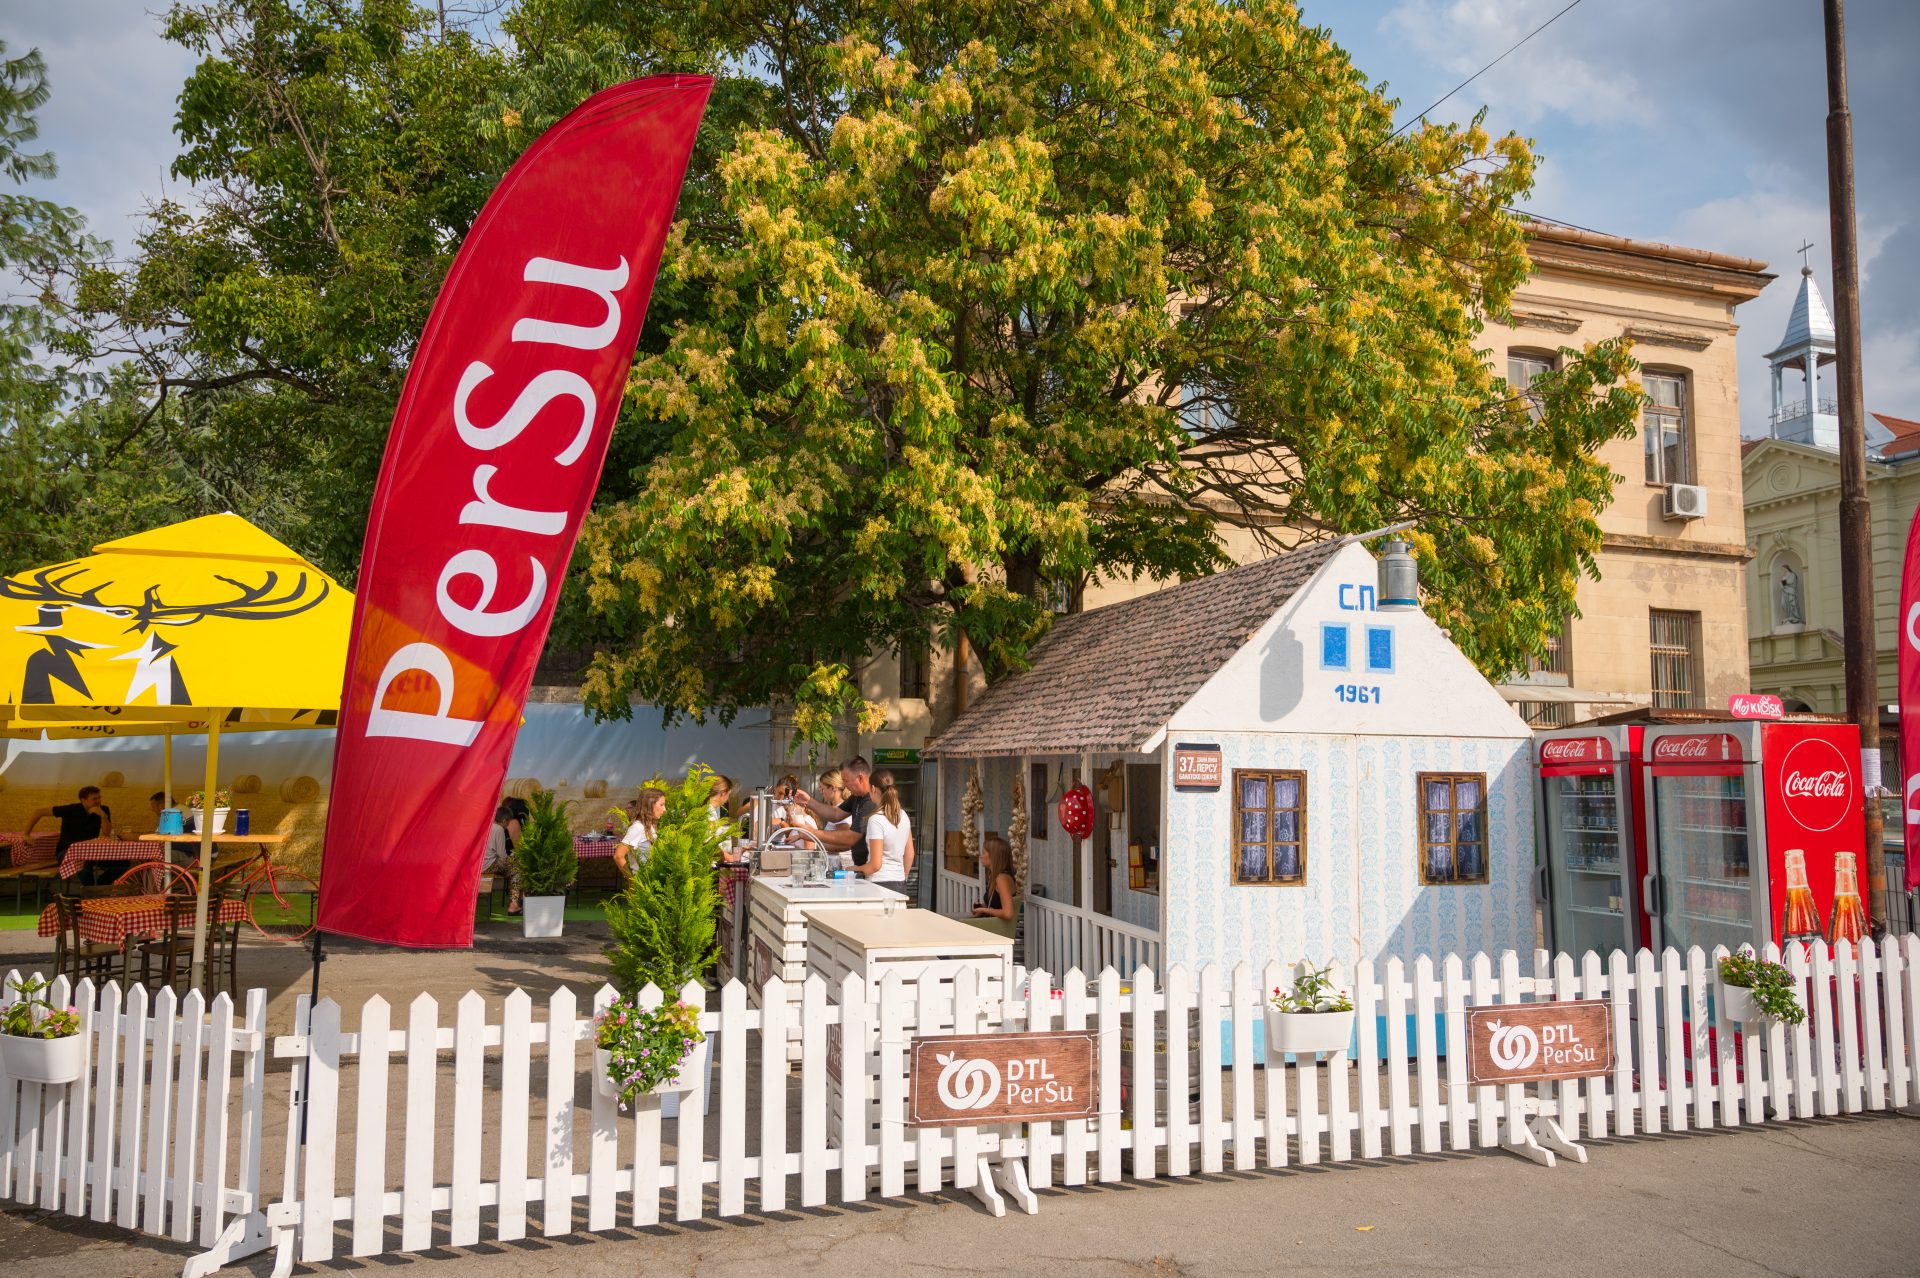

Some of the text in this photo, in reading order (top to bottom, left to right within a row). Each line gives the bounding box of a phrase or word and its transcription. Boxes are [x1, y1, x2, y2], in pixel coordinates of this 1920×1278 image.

[365, 255, 630, 746] PerSu
[1334, 684, 1380, 704] 1961
[1731, 698, 1750, 716] Moj
[1543, 741, 1587, 758] Coca-Cola
[1655, 738, 1709, 757] Coca-Cola
[1179, 756, 1197, 773] 37.
[1196, 763, 1218, 773] ПЕРСУ
[1785, 770, 1847, 797] Coca-Cola
[1542, 1024, 1580, 1044] DTL
[1543, 1043, 1596, 1065] PerSu
[1007, 1058, 1055, 1081] DTL
[1007, 1081, 1074, 1104] PerSu
